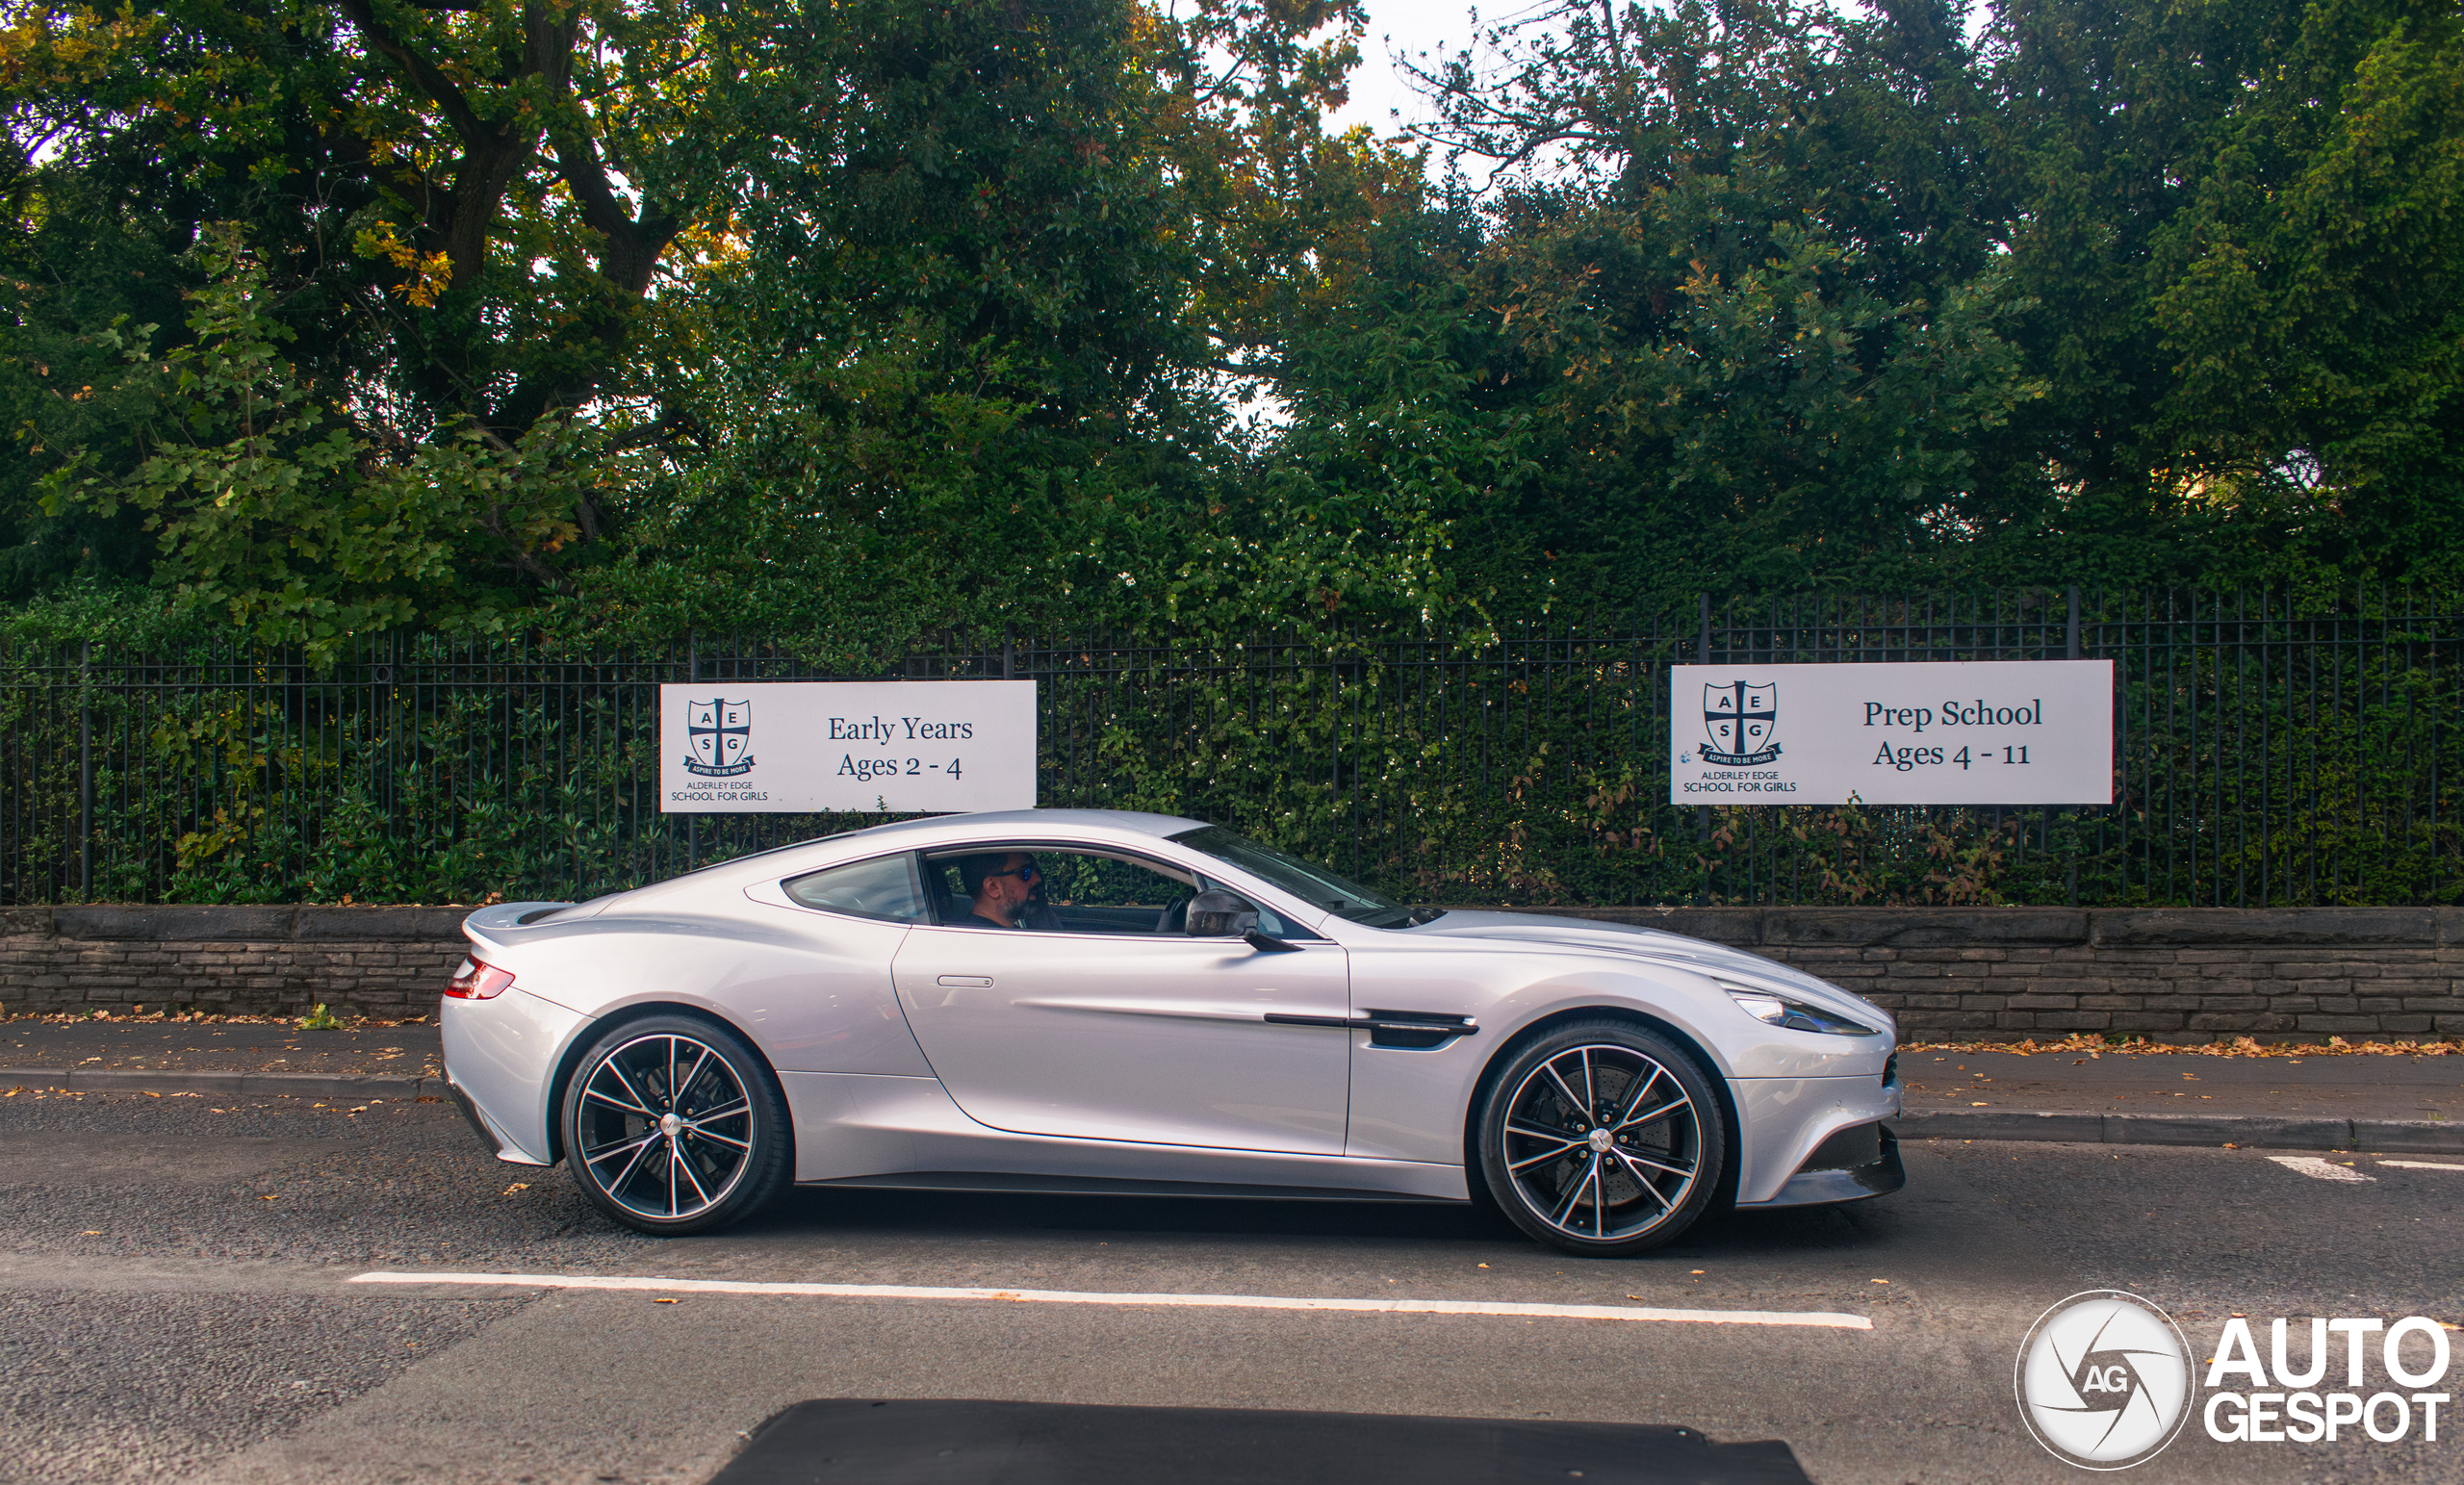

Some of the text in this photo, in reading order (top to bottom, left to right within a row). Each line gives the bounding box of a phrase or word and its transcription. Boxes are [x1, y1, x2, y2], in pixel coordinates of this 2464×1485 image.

[1718, 696, 1760, 707] A E
[701, 712, 737, 723] A E
[1862, 698, 2042, 733] Prep School
[828, 715, 973, 746] Early Years
[1719, 724, 1761, 736] S G
[702, 738, 738, 750] S G
[1708, 755, 1732, 763] ASPIRE
[1753, 754, 1772, 763] MORE
[1871, 740, 1944, 772] Ages
[1952, 745, 1971, 771] 4
[2002, 745, 2031, 765] 11
[693, 766, 712, 775] ASPIRE
[732, 765, 747, 774] MORE
[836, 753, 898, 782] Ages
[906, 757, 921, 776] 2
[946, 757, 962, 781] 4
[1701, 771, 1779, 780] ALDERLEY EDGE
[1683, 781, 1797, 792] SCHOOL FOR GIRLS
[671, 791, 769, 801] SCHOOL FOR GIRLS
